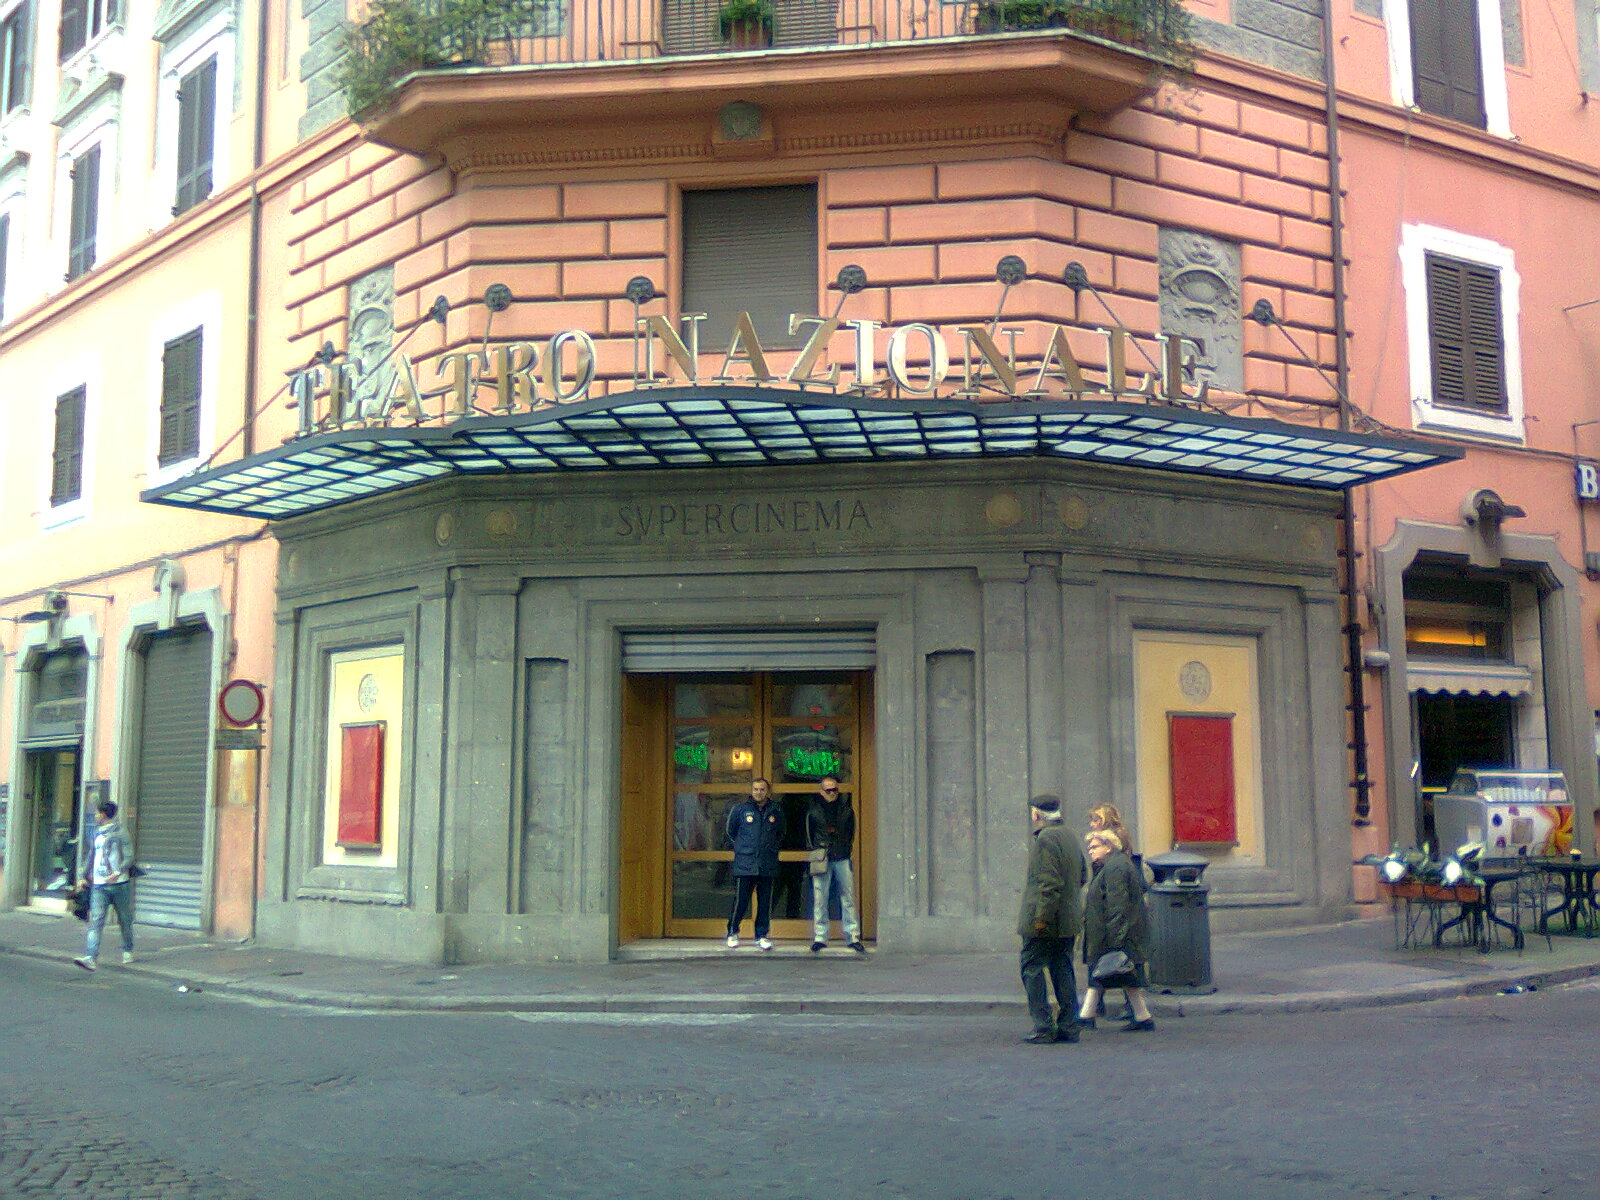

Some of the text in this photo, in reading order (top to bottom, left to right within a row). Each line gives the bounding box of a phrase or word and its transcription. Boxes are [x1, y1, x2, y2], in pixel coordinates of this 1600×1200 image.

[289, 311, 1210, 436] TEATRO NAZIONALE
[616, 499, 873, 537] SVPERCINEMA
